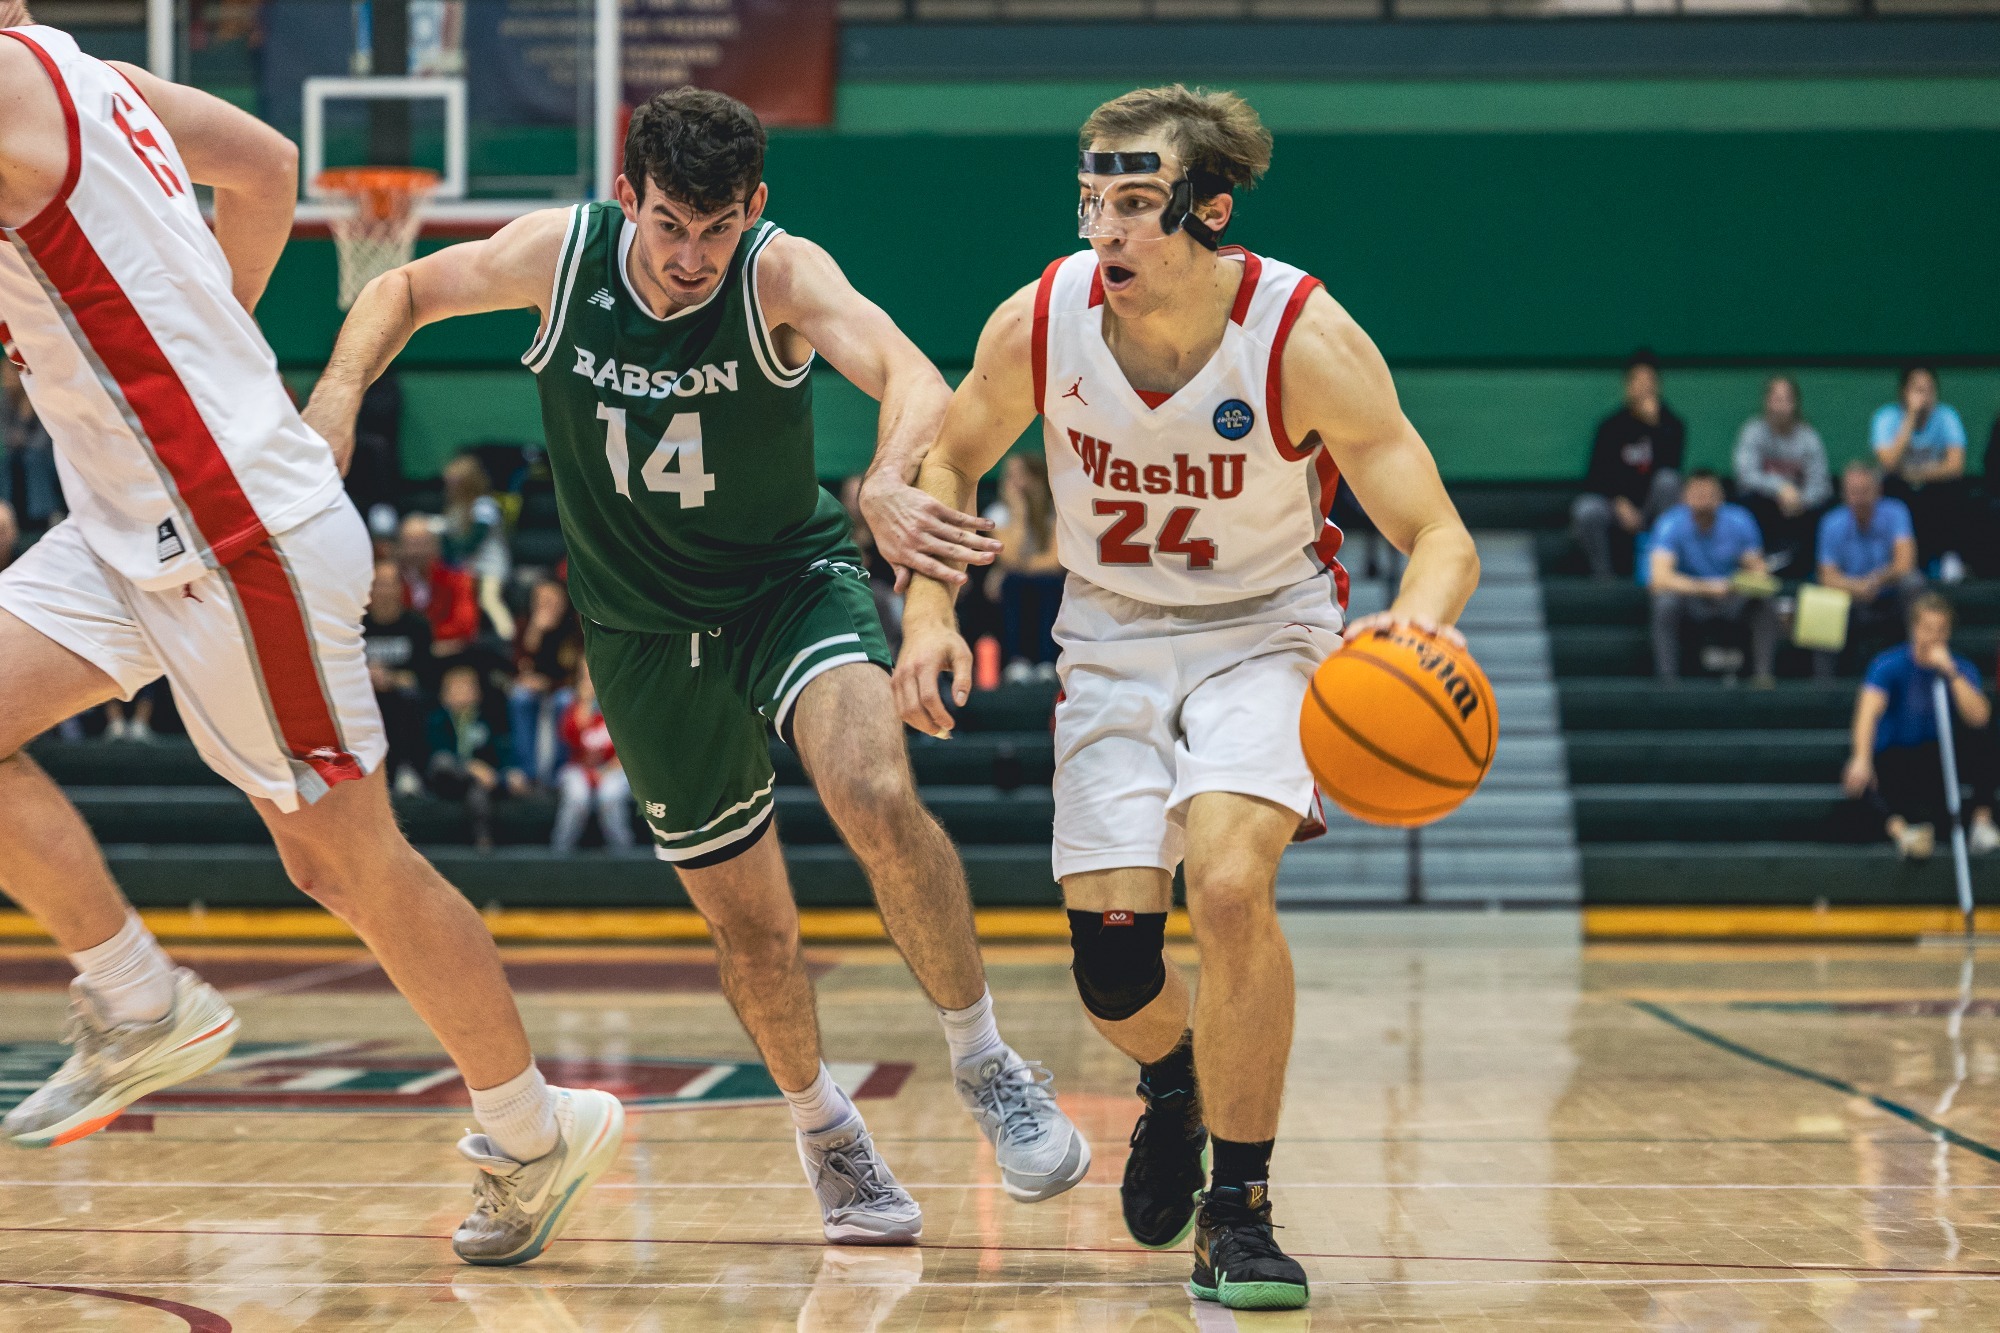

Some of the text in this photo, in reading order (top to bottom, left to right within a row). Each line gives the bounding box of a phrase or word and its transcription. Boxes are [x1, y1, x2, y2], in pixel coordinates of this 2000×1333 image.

[572, 345, 738, 399] BABSON
[596, 402, 715, 509] 14
[1067, 427, 1247, 500] WashU
[1092, 498, 1218, 570] 24
